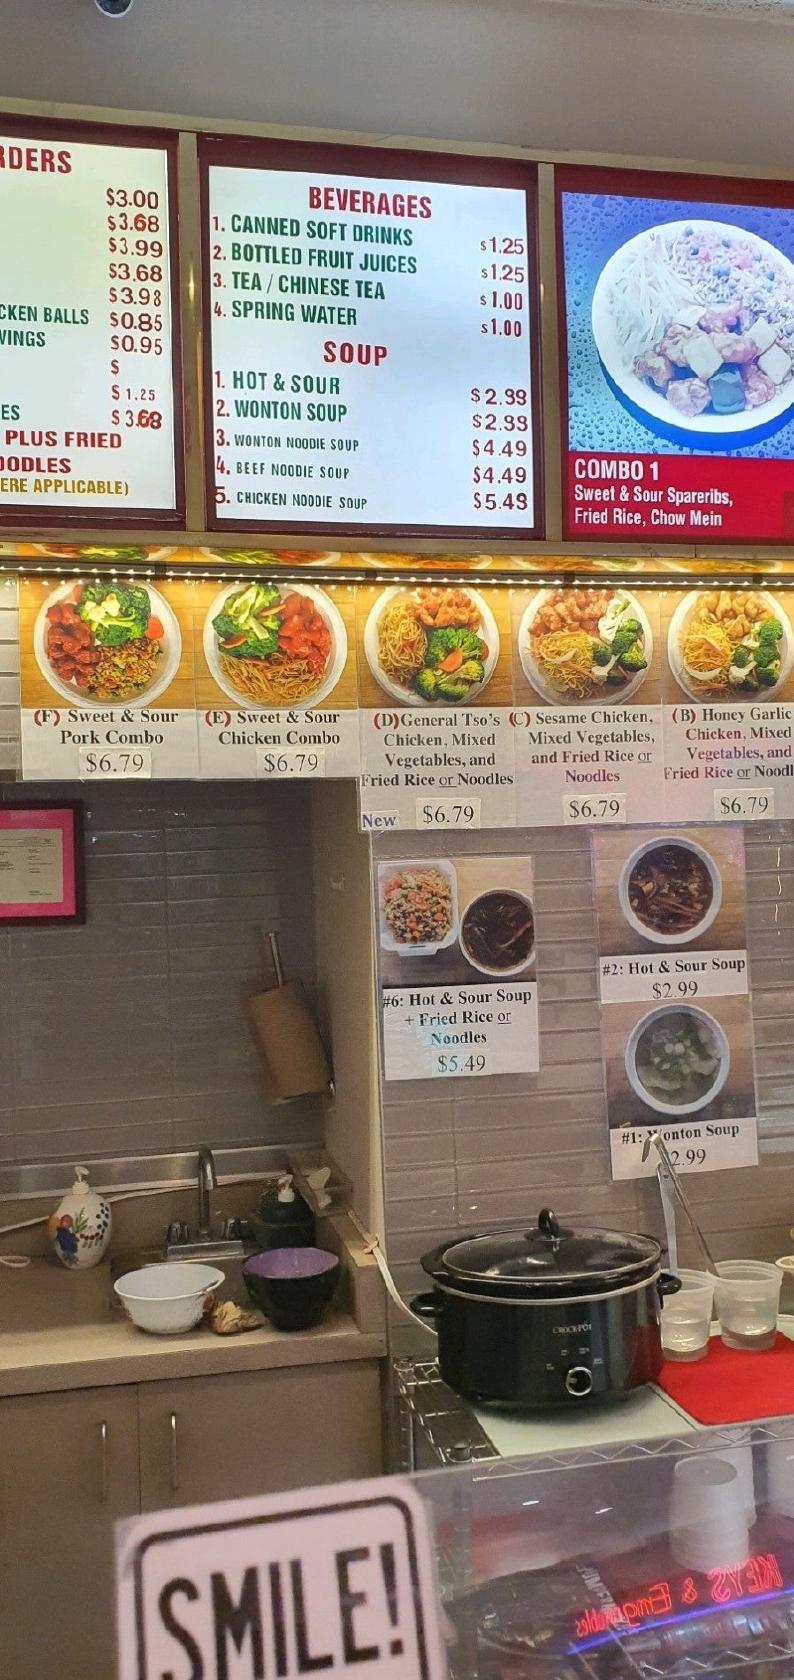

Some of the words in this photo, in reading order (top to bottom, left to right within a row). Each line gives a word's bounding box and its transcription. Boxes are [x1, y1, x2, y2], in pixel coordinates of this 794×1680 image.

[106, 187, 159, 210] $3.00
[309, 186, 432, 219] BEVERAGES
[108, 212, 160, 233] $3.68
[212, 216, 225, 232] 1.
[231, 214, 300, 237] CANNED
[306, 220, 347, 241] SOFT
[353, 224, 413, 246] DRINKS
[109, 236, 163, 258] $3.99
[481, 237, 524, 255] $1.25
[213, 245, 226, 261] 2.
[231, 243, 301, 265] BOTTLED
[308, 248, 354, 269] FRUIT
[359, 252, 417, 274] JUICES
[109, 263, 163, 282] $3.68
[481, 265, 525, 283] $1.25
[213, 272, 226, 289] 3.
[232, 271, 262, 291] TEA
[266, 273, 274, 294] /
[278, 274, 350, 297] CHINESE
[355, 280, 385, 300] TEA
[109, 287, 161, 307] $3.98
[480, 291, 523, 311] $1.00
[44, 307, 89, 325] BALLS
[110, 311, 163, 332] $0.85
[213, 302, 226, 317] 4.
[232, 300, 295, 322] SPRING
[301, 305, 357, 326] WATER
[481, 318, 522, 338] $1.00
[110, 335, 163, 356] $0.95
[323, 341, 387, 366] SOUP
[111, 359, 120, 376] $
[214, 370, 225, 389] 1.
[233, 370, 268, 391] HOT
[273, 373, 285, 392] &
[291, 375, 341, 395] SOUR
[216, 399, 230, 417] 2.
[234, 399, 301, 420] WONTON
[307, 403, 348, 423] SOUP
[5, 430, 57, 447] PLUS
[64, 431, 122, 449] FRIED
[216, 429, 230, 447] 3.
[234, 433, 282, 449] WONTON
[330, 438, 359, 451] SOUP
[472, 439, 528, 458] $4.49
[215, 456, 230, 475] 4.
[236, 461, 266, 476] BEEF
[320, 466, 350, 480] SOUP
[473, 466, 527, 484] $4.49
[574, 458, 644, 481] COMBO
[650, 461, 659, 481] 1
[33, 479, 129, 497] APPLICABLE)
[574, 484, 615, 502] Sweet
[619, 485, 630, 501] &
[634, 485, 663, 503] Sour
[667, 487, 733, 508] Spareribs,
[236, 491, 287, 506] CHICKEN
[339, 496, 368, 510] SOUP
[575, 507, 608, 525] Fried
[613, 508, 646, 527] Rice,
[651, 509, 685, 526] Chow
[690, 510, 722, 526] Mein
[33, 709, 61, 727] (F)
[68, 711, 115, 724] Sweet
[121, 711, 135, 724] &
[140, 711, 179, 723] Sour
[205, 710, 232, 727] (E)
[237, 711, 281, 724] Sweet
[286, 711, 300, 724] &
[304, 711, 340, 724] Sour
[461, 713, 501, 727] Tso's
[509, 711, 531, 728] (C)
[536, 711, 588, 725] Sesame
[591, 710, 653, 725] Chicken,
[672, 708, 697, 724] (B)
[703, 708, 745, 723] Honey
[750, 707, 792, 720] Garlic
[60, 730, 100, 745] Pork
[105, 730, 164, 746] Combo
[218, 731, 281, 745] Chicken
[286, 731, 340, 746] Combo
[384, 733, 448, 748] Chicken,
[452, 733, 496, 746] Mixed
[529, 731, 571, 745] Mixed
[576, 730, 655, 746] Vegetables,
[685, 728, 747, 742] Chicken,
[750, 726, 792, 739] Mixed
[385, 753, 466, 768] Vegetables,
[469, 753, 496, 766] and
[531, 751, 558, 765] and
[562, 750, 600, 763] Fried
[604, 750, 634, 762] Rice
[637, 752, 652, 764] or
[687, 746, 764, 761] Vegetables,
[767, 745, 792, 758] and
[85, 753, 144, 774] $6.79
[263, 753, 319, 773] $6.79
[361, 773, 400, 787] Fried
[404, 773, 435, 786] Rice
[438, 776, 457, 788] or
[457, 772, 514, 786] Noodles
[565, 769, 620, 783] Noodles
[664, 767, 699, 780] Fried
[704, 766, 733, 778] Rice
[737, 768, 751, 780] or
[423, 805, 475, 825] $6.79
[569, 799, 620, 819] $6.79
[720, 796, 769, 815] $6.79
[362, 814, 397, 828] New
[602, 965, 624, 977] #2:
[628, 962, 654, 975] Hot
[658, 960, 671, 973] &
[675, 959, 708, 973] Sour
[711, 957, 746, 972] Soup
[383, 994, 404, 1008] #6:
[409, 993, 436, 1006] Hot
[440, 991, 454, 1005] &
[458, 990, 493, 1005] Sour
[496, 988, 532, 1005] Soup
[652, 980, 699, 999] $2.99
[404, 1014, 415, 1026] +
[418, 1012, 457, 1027] Fried
[462, 1010, 493, 1024] Rice
[497, 1011, 512, 1025] or
[431, 1031, 487, 1046] Noodles
[438, 1054, 487, 1073] $5.49
[621, 1132, 642, 1145] #1:
[706, 1124, 740, 1137] Soup
[158, 1542, 405, 1680] SMILE!
